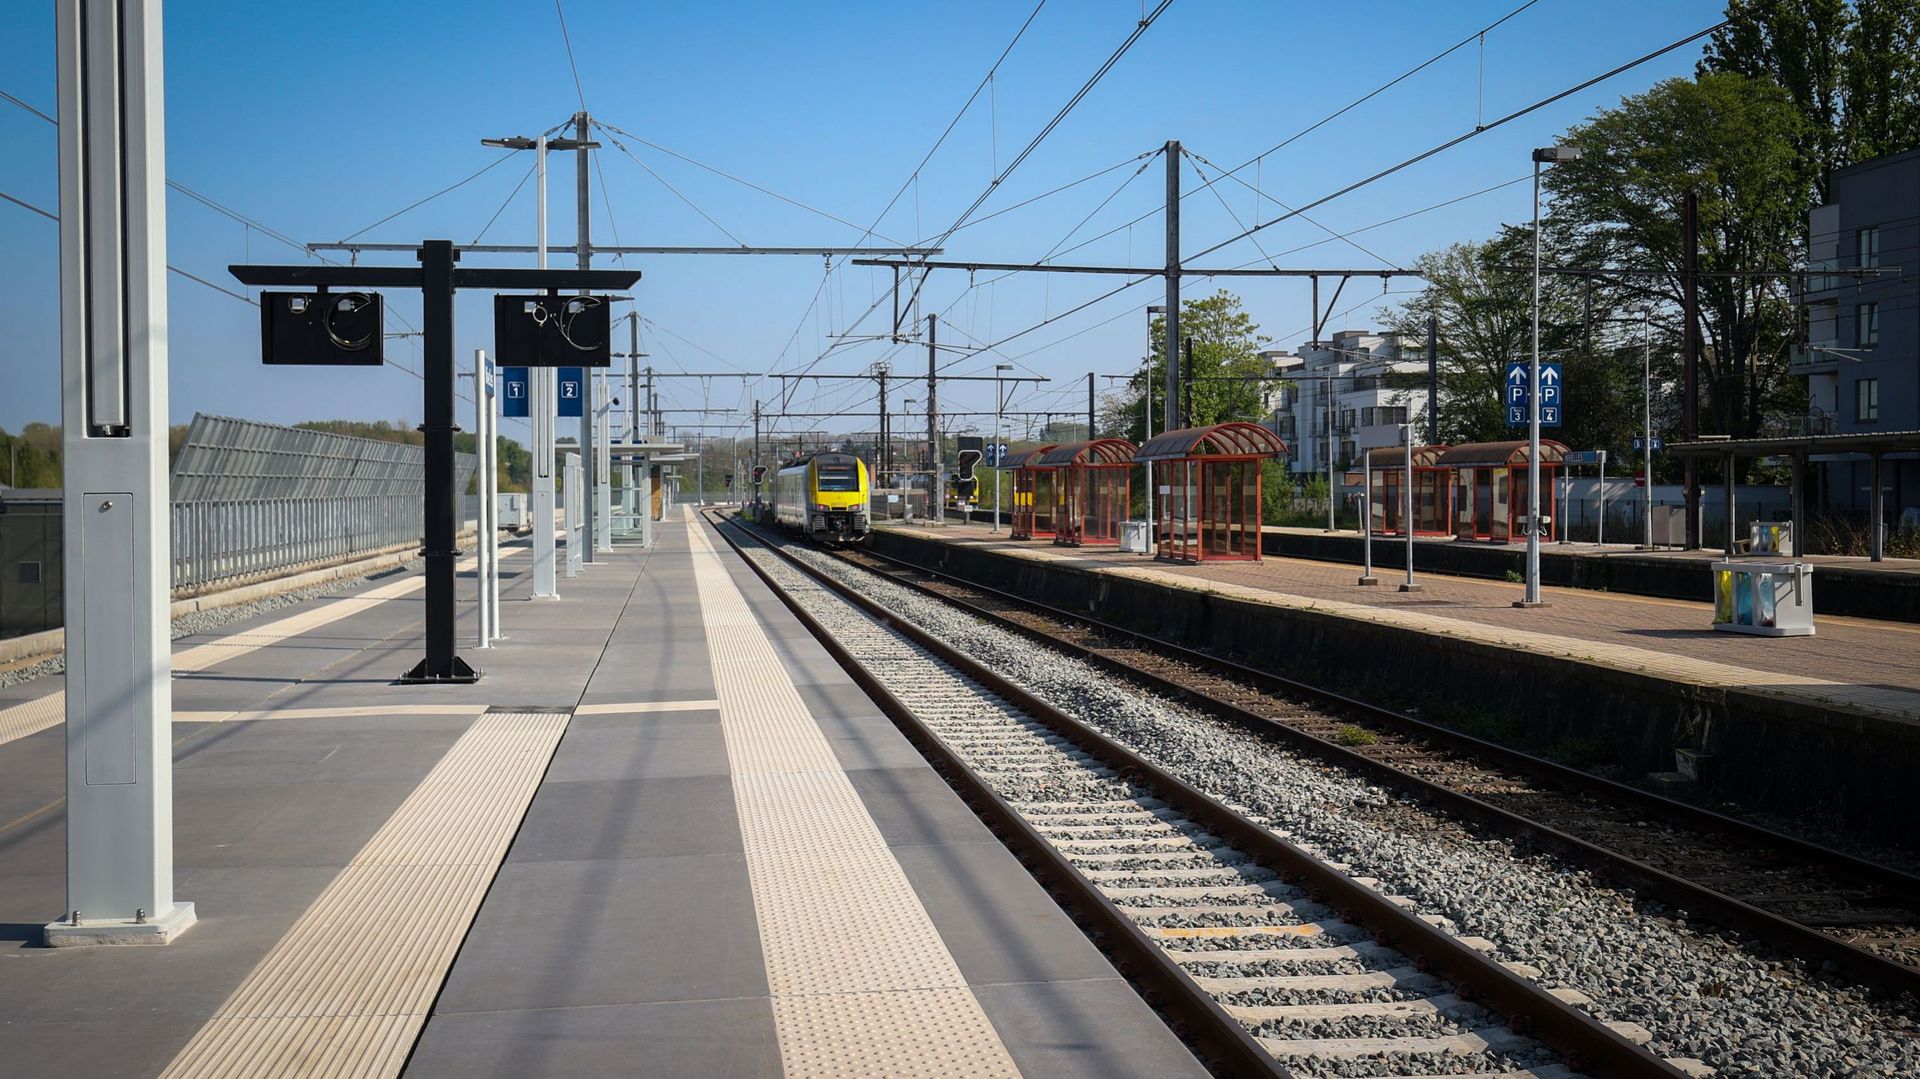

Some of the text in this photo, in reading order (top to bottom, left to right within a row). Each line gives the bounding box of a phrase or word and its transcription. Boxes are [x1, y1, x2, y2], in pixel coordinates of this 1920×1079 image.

[513, 387, 518, 397] 1
[566, 387, 573, 397] 2
[1513, 388, 1523, 402] P
[1545, 388, 1554, 402] P
[1514, 412, 1520, 420] 3
[1546, 412, 1553, 421] 4
